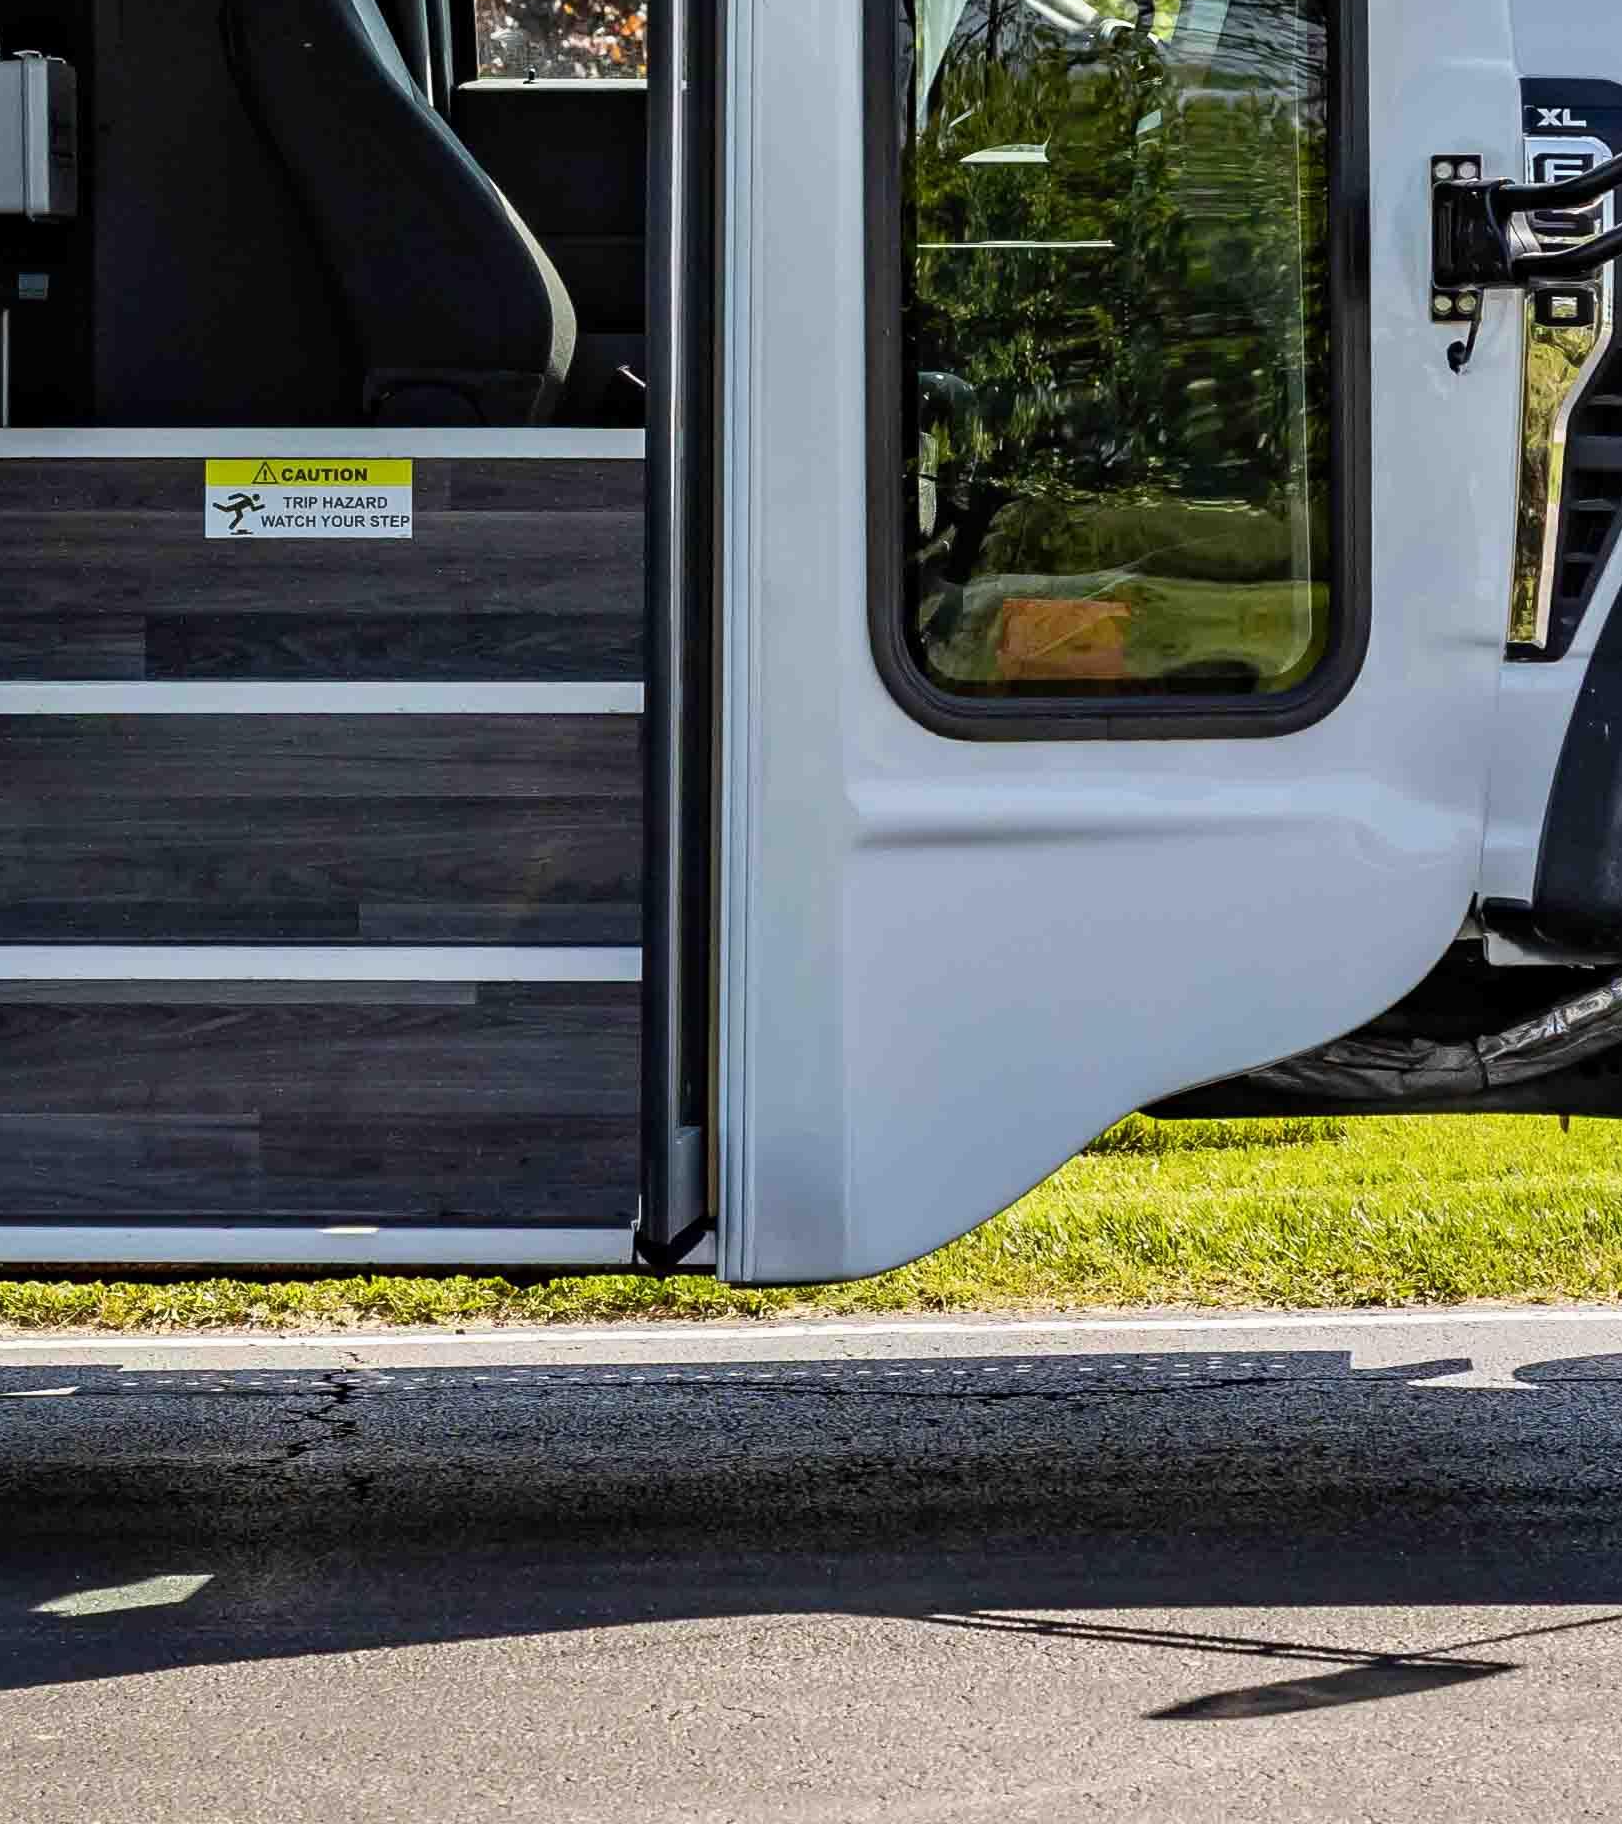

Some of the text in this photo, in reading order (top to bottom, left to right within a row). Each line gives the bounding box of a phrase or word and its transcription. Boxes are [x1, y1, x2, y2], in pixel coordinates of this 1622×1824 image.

[1537, 108, 1587, 127] XL
[281, 467, 368, 482] CAUTION
[283, 496, 388, 509] TRIP HAZARD
[260, 515, 411, 528] WATCH YOUR STEP
